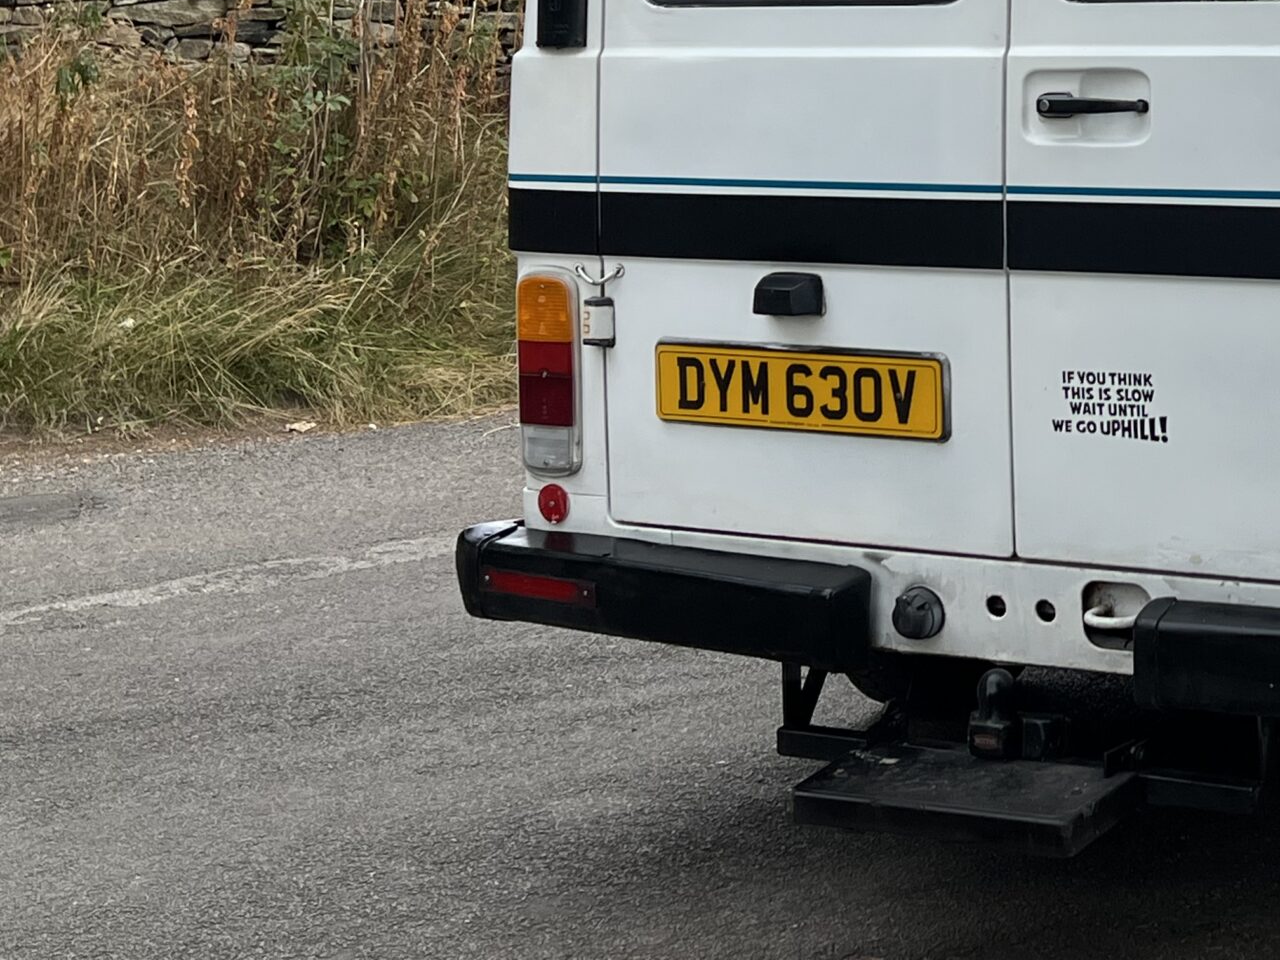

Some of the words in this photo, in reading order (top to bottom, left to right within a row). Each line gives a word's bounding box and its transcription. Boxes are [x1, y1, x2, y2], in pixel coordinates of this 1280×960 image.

[1062, 371, 1075, 384] IF
[1077, 371, 1106, 385] YOU
[1108, 372, 1153, 387] THINK
[677, 356, 769, 415] DYM
[786, 363, 916, 425] 630V
[1062, 386, 1094, 400] THIS
[1098, 387, 1112, 401] IS
[1116, 388, 1154, 402] SLOW
[1069, 401, 1105, 416] WAIT
[1108, 403, 1148, 417] UNTIL
[1052, 419, 1072, 432] WE
[1076, 420, 1097, 433] GO
[1100, 416, 1168, 443] UPHILL!
